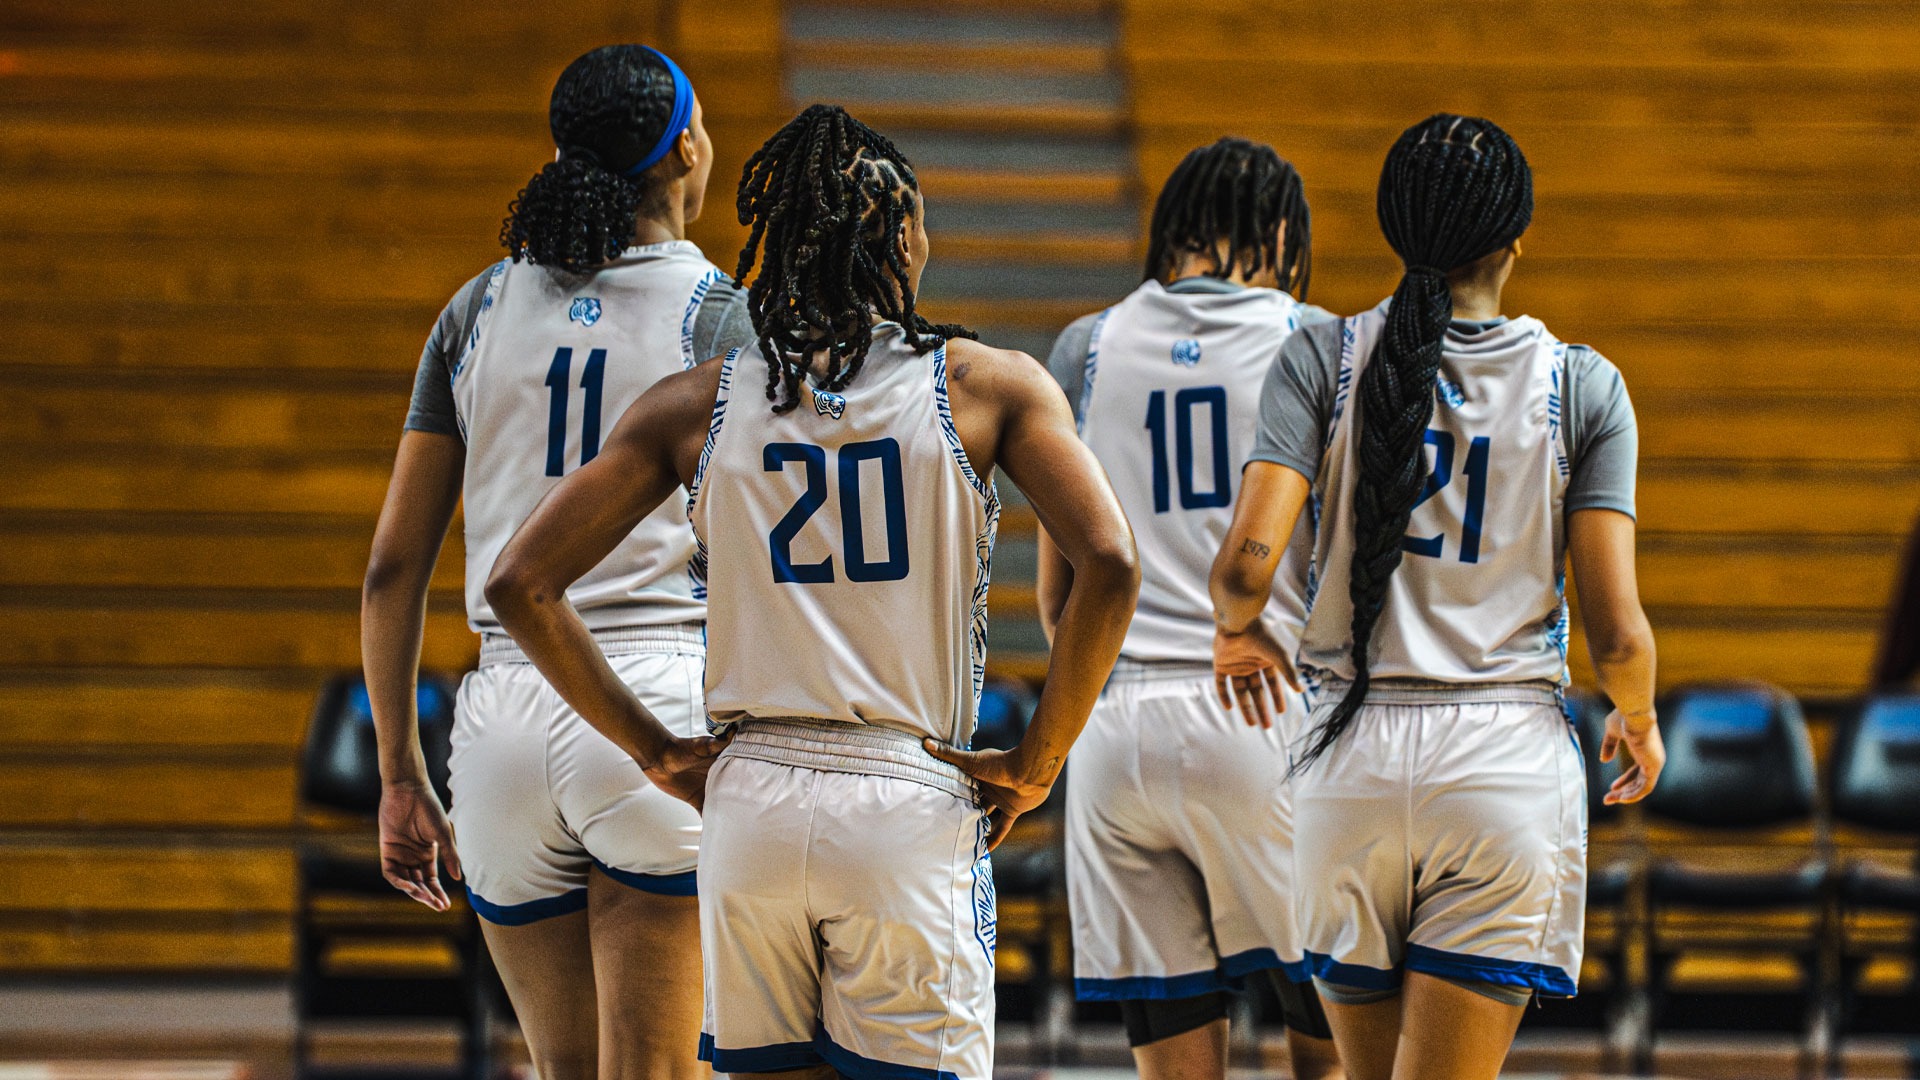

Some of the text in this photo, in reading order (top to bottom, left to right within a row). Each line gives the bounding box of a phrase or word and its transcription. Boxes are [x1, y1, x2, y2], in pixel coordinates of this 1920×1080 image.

[544, 346, 608, 477] 11
[1145, 385, 1232, 515] 10
[763, 437, 909, 584] 20
[1239, 537, 1270, 560] 1979
[1400, 427, 1491, 564] 21
